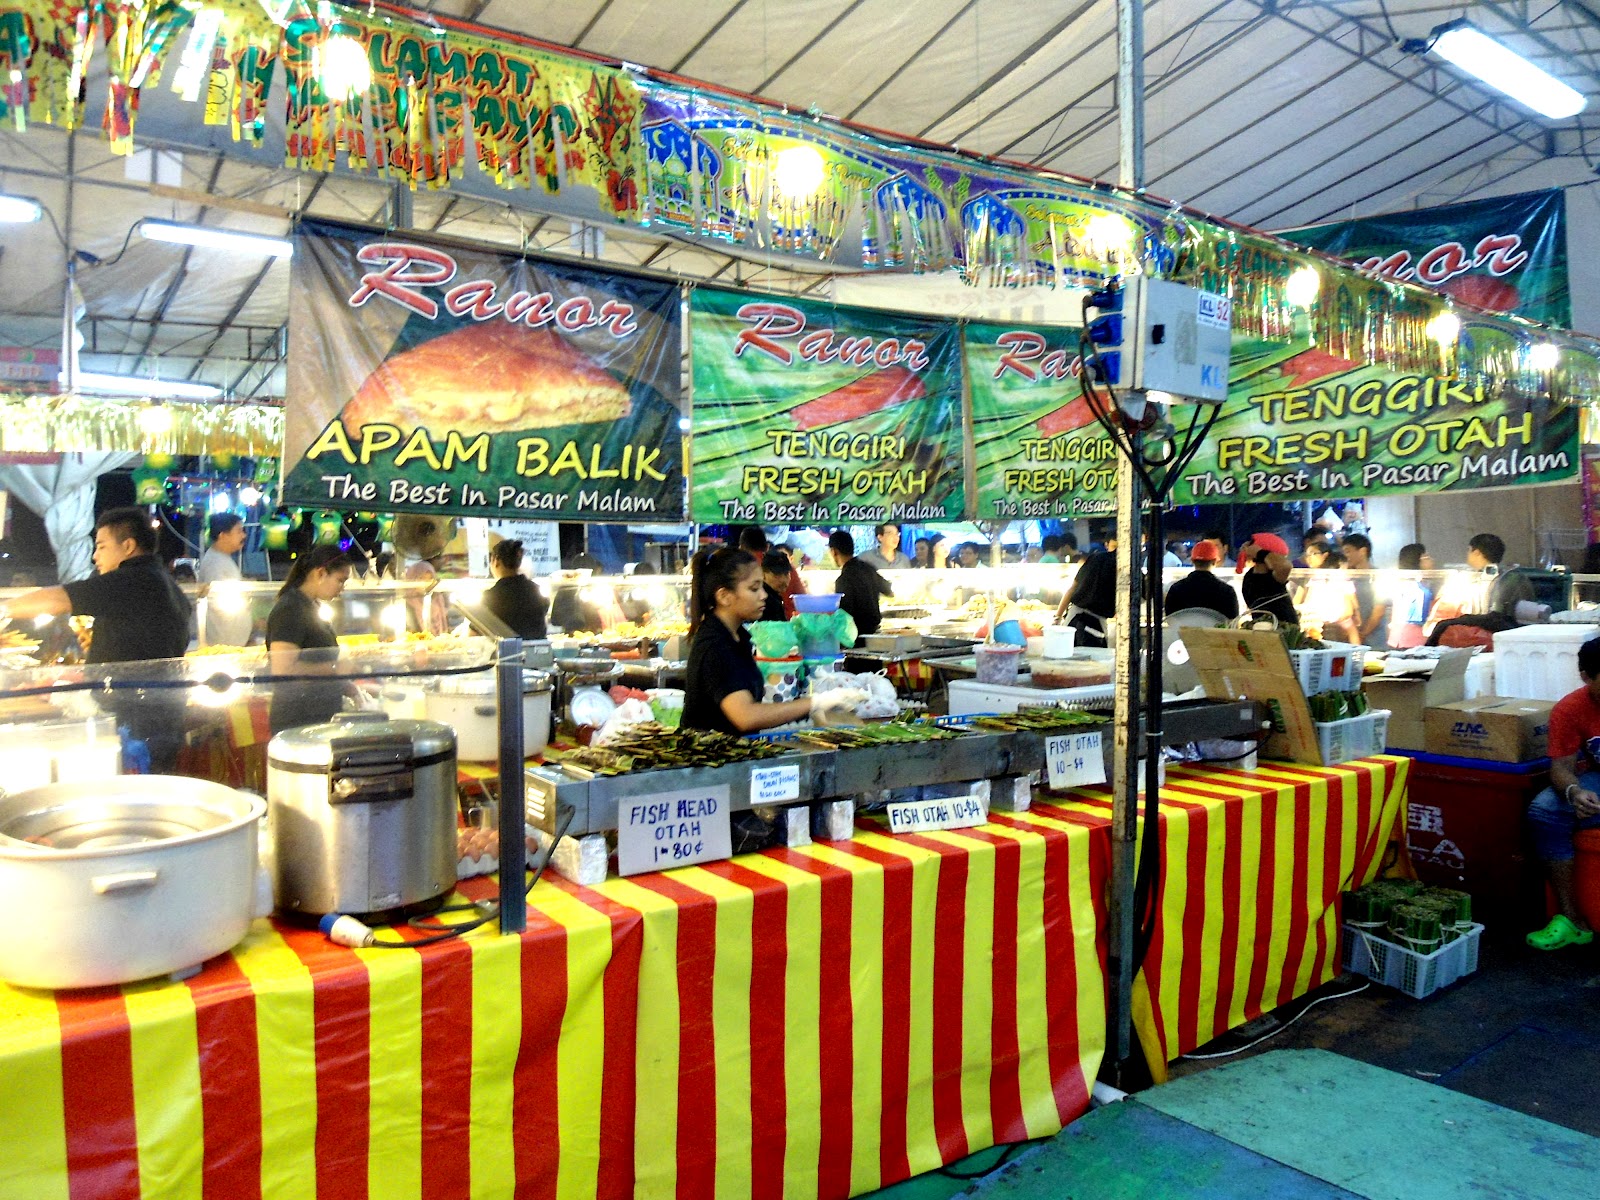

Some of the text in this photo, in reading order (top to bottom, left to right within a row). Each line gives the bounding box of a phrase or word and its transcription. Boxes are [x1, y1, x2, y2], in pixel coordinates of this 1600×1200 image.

[280, 15, 540, 99] SLAMAT
[349, 243, 639, 338] Ranor
[733, 302, 930, 371] Ranor
[306, 420, 667, 481] APAM BALIK
[767, 430, 906, 461] TENGGIRI
[1020, 437, 1119, 461] TENGGIR
[1219, 412, 1533, 470] FRESH OTAH
[742, 466, 928, 495] FRESH OTAH
[1004, 470, 1078, 493] FRESH
[1186, 448, 1569, 496] The Best In Pasar Malam
[321, 474, 656, 512] The Best In Pasar Malam
[993, 500, 1015, 516] The
[1021, 498, 1049, 515] Best
[1054, 497, 1067, 514] In
[1072, 498, 1109, 512] Pasar
[720, 500, 946, 521] The Best In Pasar Malam
[1050, 735, 1099, 756] FISH OTAH
[630, 798, 718, 825] FISH HEAD
[892, 807, 920, 826] FISH
[923, 805, 950, 823] OTAH
[655, 820, 701, 840] OTAH
